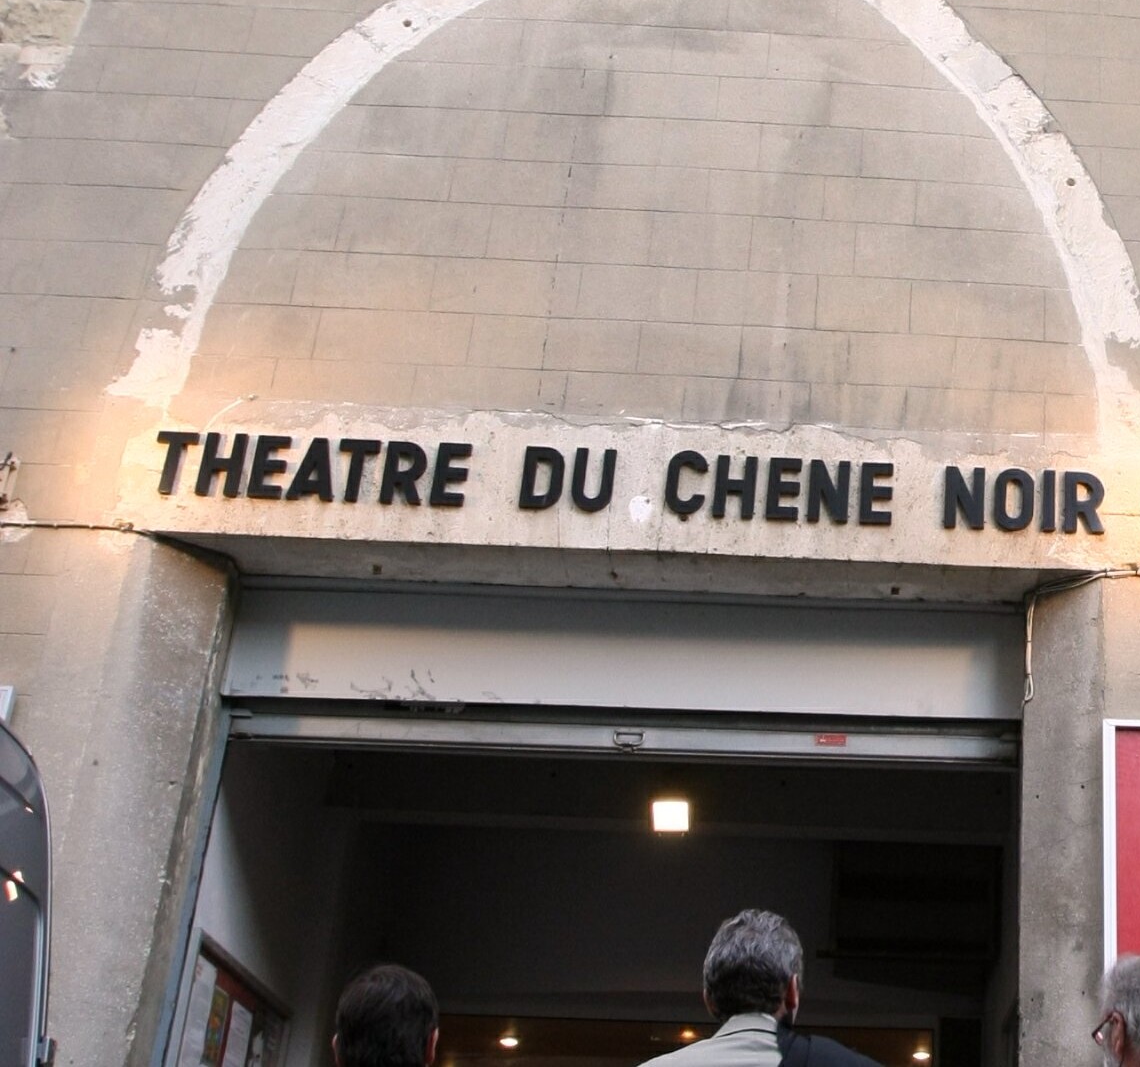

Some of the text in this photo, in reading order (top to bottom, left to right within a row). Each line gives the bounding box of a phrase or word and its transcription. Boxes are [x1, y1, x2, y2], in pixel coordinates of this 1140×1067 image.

[156, 430, 1105, 535] THEATRE DU CHENE NOIR
